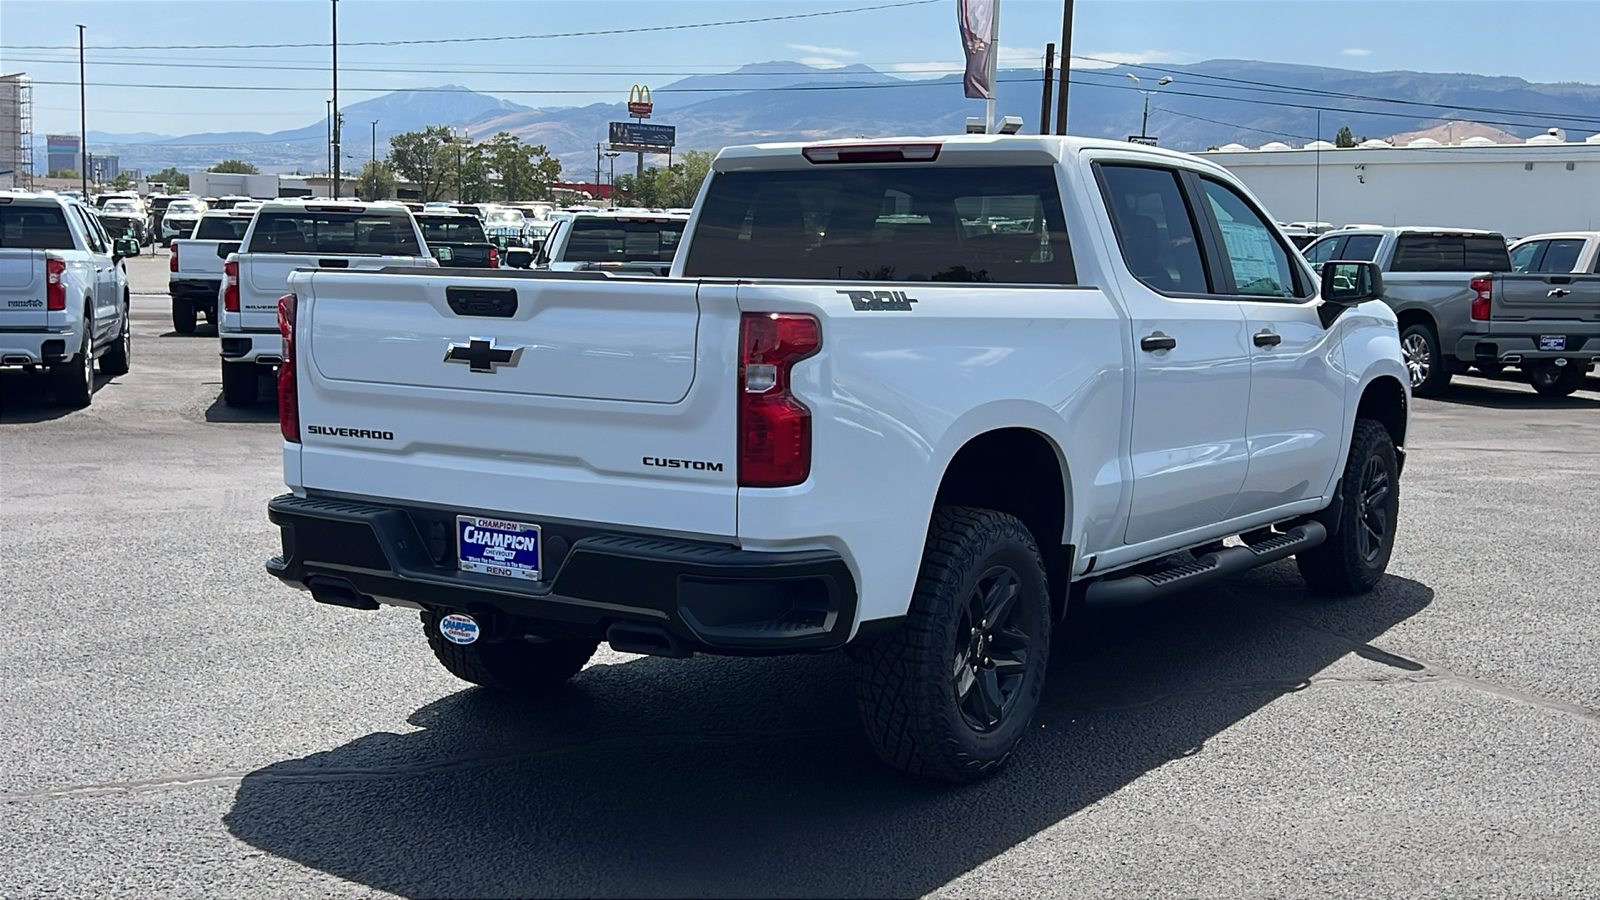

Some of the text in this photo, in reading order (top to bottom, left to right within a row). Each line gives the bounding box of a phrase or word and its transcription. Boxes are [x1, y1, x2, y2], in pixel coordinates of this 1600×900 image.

[308, 425, 394, 440] SILVERADO
[642, 456, 723, 472] CUSTOM
[478, 519, 518, 531] CHAMPION
[463, 525, 535, 552] CHAMPION
[485, 548, 514, 558] CHEVROLET
[486, 566, 512, 576] RENO
